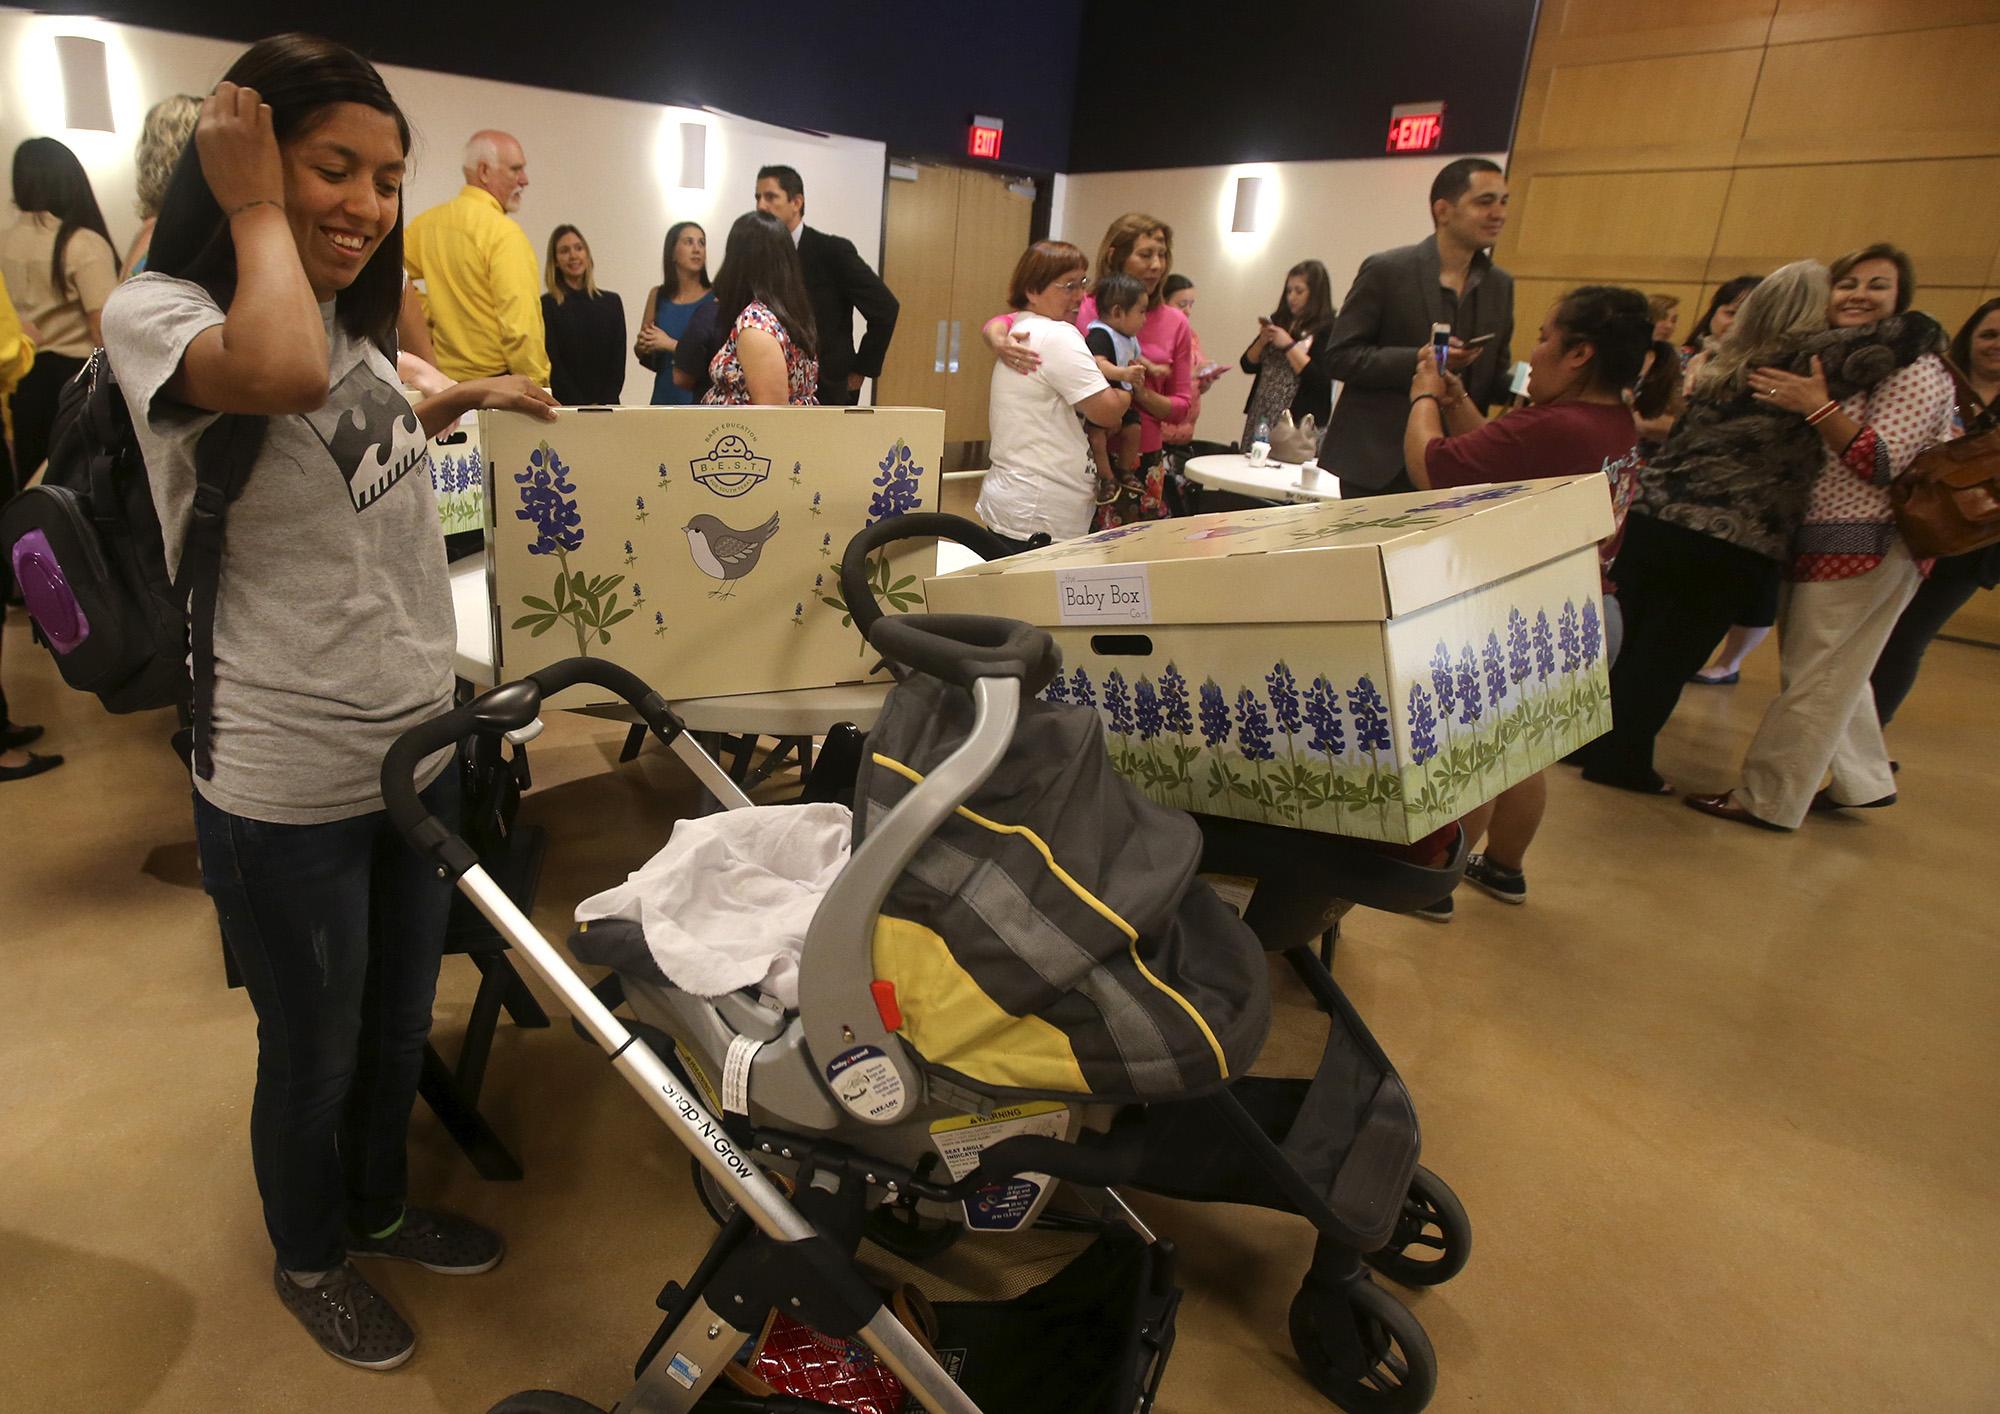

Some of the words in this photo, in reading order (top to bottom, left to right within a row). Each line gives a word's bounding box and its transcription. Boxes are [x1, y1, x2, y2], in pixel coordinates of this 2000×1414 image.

[974, 127, 998, 157] EXIT
[1396, 115, 1437, 150] EXIT
[704, 427, 719, 443] BABY
[721, 423, 758, 442] EDUCATION
[1065, 584, 1105, 611] Baby
[1110, 584, 1140, 604] Box
[832, 1060, 848, 1071] baby
[851, 1048, 869, 1061] trend
[977, 1108, 1022, 1121] WRNING
[946, 1151, 978, 1160] INDICATO
